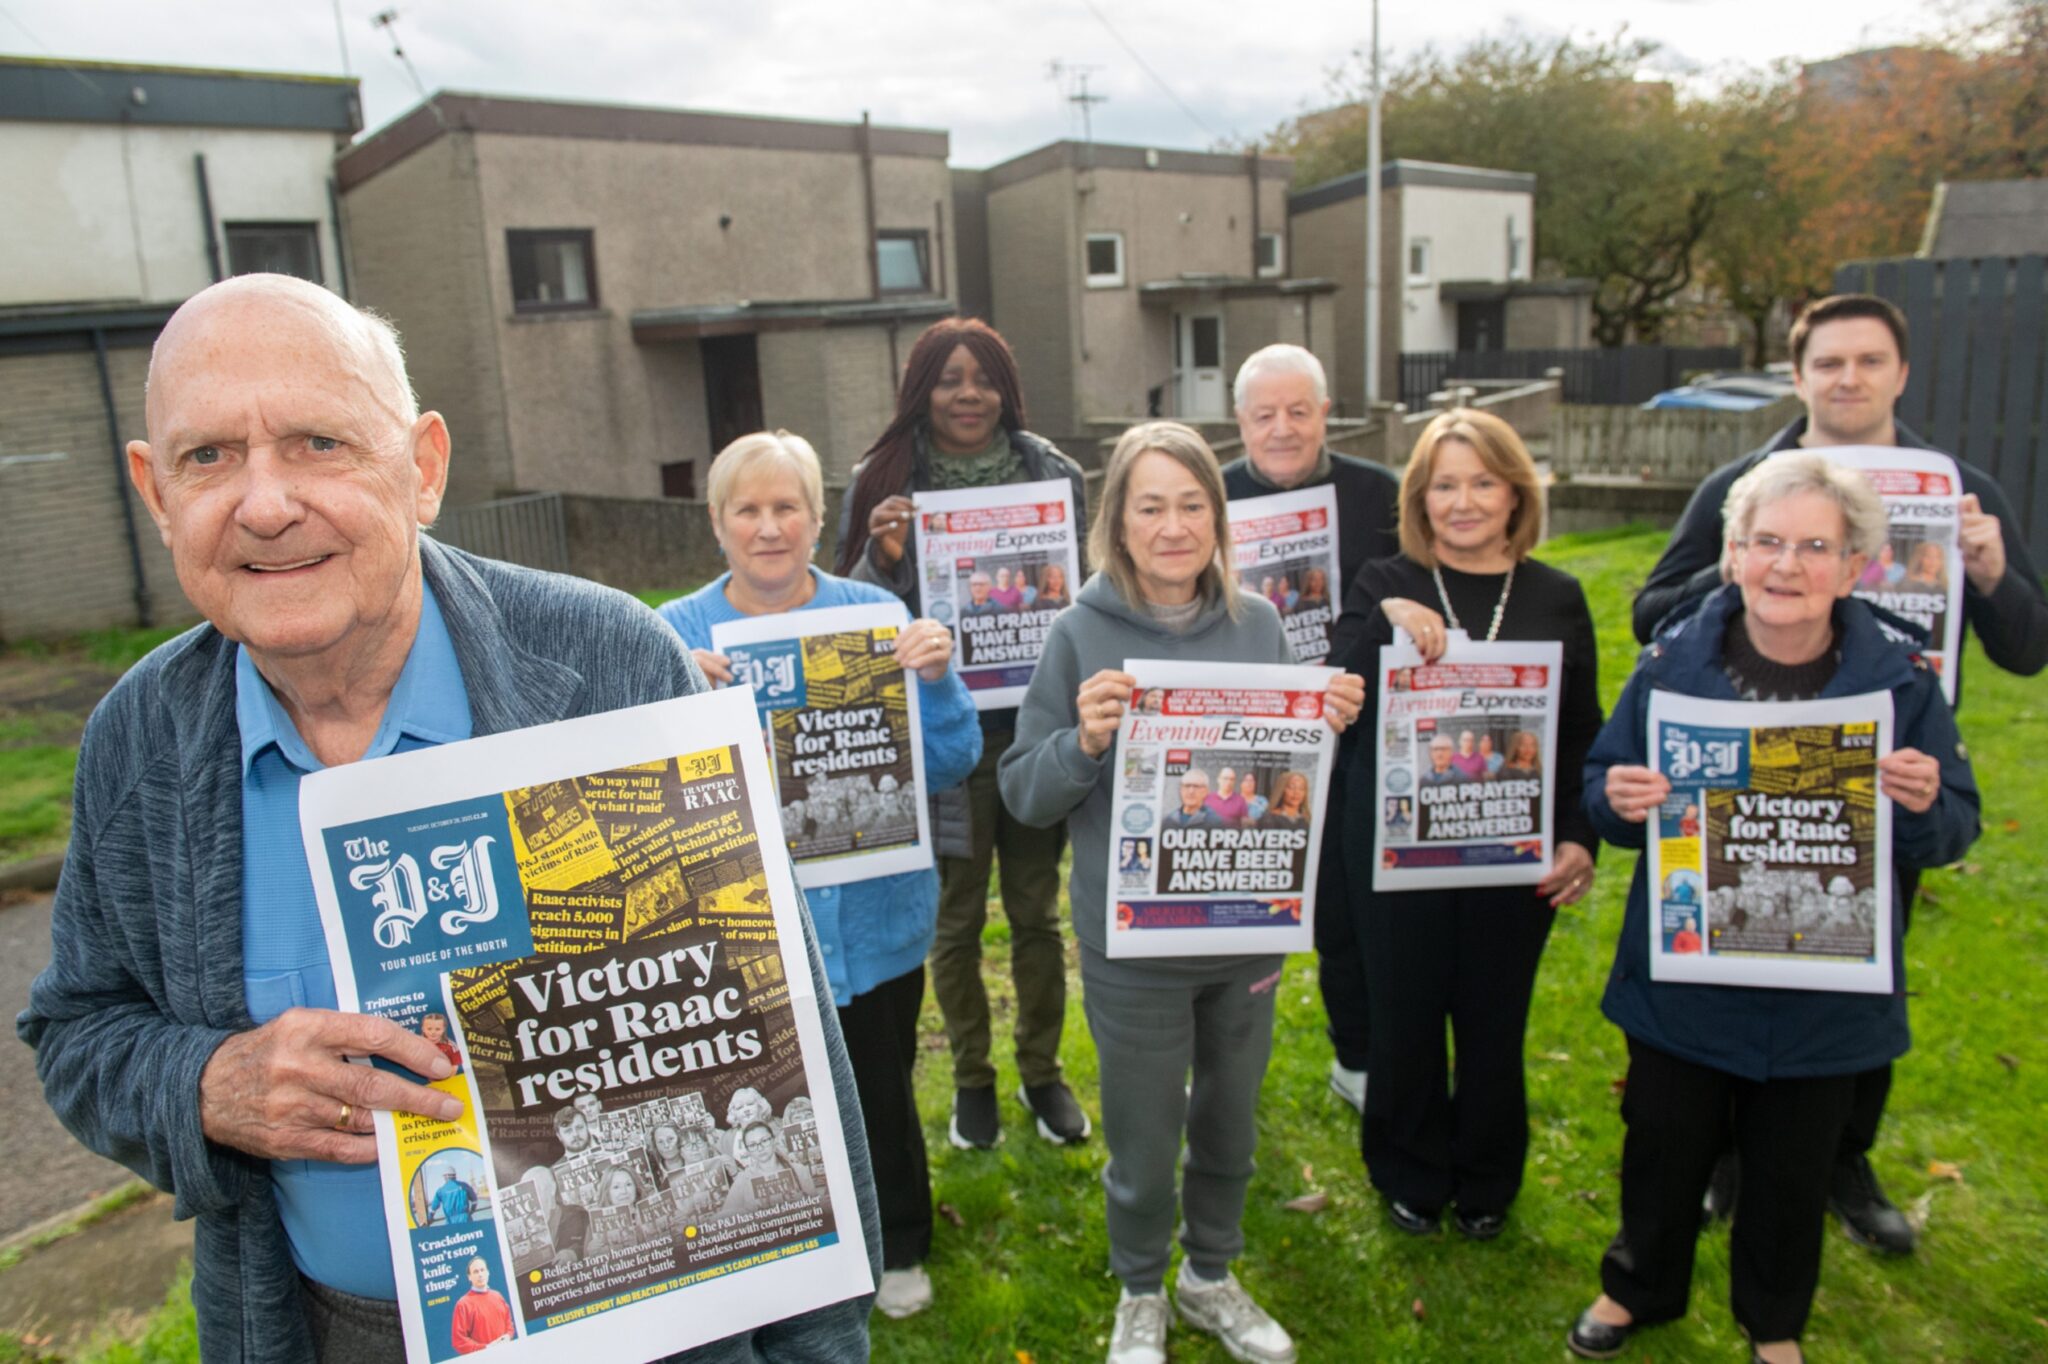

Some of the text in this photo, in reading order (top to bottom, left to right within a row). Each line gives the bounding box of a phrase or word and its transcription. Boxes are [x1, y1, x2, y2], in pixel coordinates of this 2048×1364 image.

[1888, 502, 1955, 519] press
[995, 529, 1067, 550] Express
[1259, 534, 1330, 560] Express
[961, 615, 996, 633] OUR
[970, 629, 1018, 648] HAVE
[1459, 690, 1548, 714] Express
[797, 706, 884, 734] Victory
[794, 726, 891, 755] for Raac
[1128, 719, 1324, 748] Evening Express
[791, 746, 898, 777] residents
[585, 788, 664, 801] settle for half
[605, 776, 660, 789] way will I
[681, 776, 738, 796] TRAPPED BY
[1421, 779, 1541, 805] OUR PRAYERS
[599, 802, 627, 813] what
[629, 802, 636, 813] I
[682, 785, 742, 811] RAAC
[1429, 798, 1532, 822] HAVE BEEN
[1735, 794, 1845, 821] Victory
[526, 806, 583, 851] HOME OWNERS
[626, 816, 677, 849] residents
[671, 809, 740, 842] Readers get
[676, 822, 744, 855] behind P&J
[1427, 816, 1534, 839] ANSWERED
[1729, 815, 1852, 841] for Raac
[343, 835, 391, 862] The
[518, 829, 599, 871] P&J stands with
[621, 833, 670, 868] low value
[681, 848, 711, 868] Raac
[710, 831, 758, 859] petition
[1161, 828, 1307, 850] OUR PRAYERS
[524, 840, 601, 879] victims of Raac
[1171, 850, 1293, 870] HAVE BEEN
[1723, 840, 1858, 865] residents
[632, 858, 650, 876] for
[1168, 870, 1294, 892] ANSWERED
[532, 892, 623, 909] Raac activists
[531, 909, 615, 925] reach 5,000
[666, 917, 694, 935] slam
[530, 924, 620, 941] signatures in
[725, 929, 767, 943] of swap
[379, 938, 508, 972] YOUR VOICE OF THE NORTH
[453, 971, 502, 1003] Support
[513, 941, 718, 1014] Victory
[365, 991, 425, 1011] Tributes to
[400, 1003, 429, 1018] after
[460, 986, 508, 1013] fighting
[515, 1018, 599, 1062] for
[605, 987, 742, 1044] Raac
[467, 1031, 499, 1047] Raac
[517, 1028, 763, 1108] residents
[401, 1122, 414, 1132] as
[403, 1126, 464, 1144] crisis grows
[697, 1194, 821, 1236] The P&J has stood shoulder
[686, 1206, 824, 1251] to shoulder with community in
[689, 1218, 824, 1263] relentless campaign for justice
[452, 1244, 479, 1261] stop
[543, 1235, 674, 1280] Relief as Torry homeowners
[423, 1263, 453, 1281] knife
[530, 1246, 675, 1298] to receive the full value for their
[533, 1258, 677, 1312] properties after two-year battle
[546, 1307, 587, 1328] EXCLUSIVE
[586, 1298, 616, 1316] REPORT
[615, 1293, 632, 1307] AND
[631, 1283, 668, 1303] REACTION
[667, 1279, 680, 1290] TO
[679, 1273, 697, 1288] CITY
[732, 1257, 753, 1273] CASH
[781, 1243, 805, 1258] PAGES
